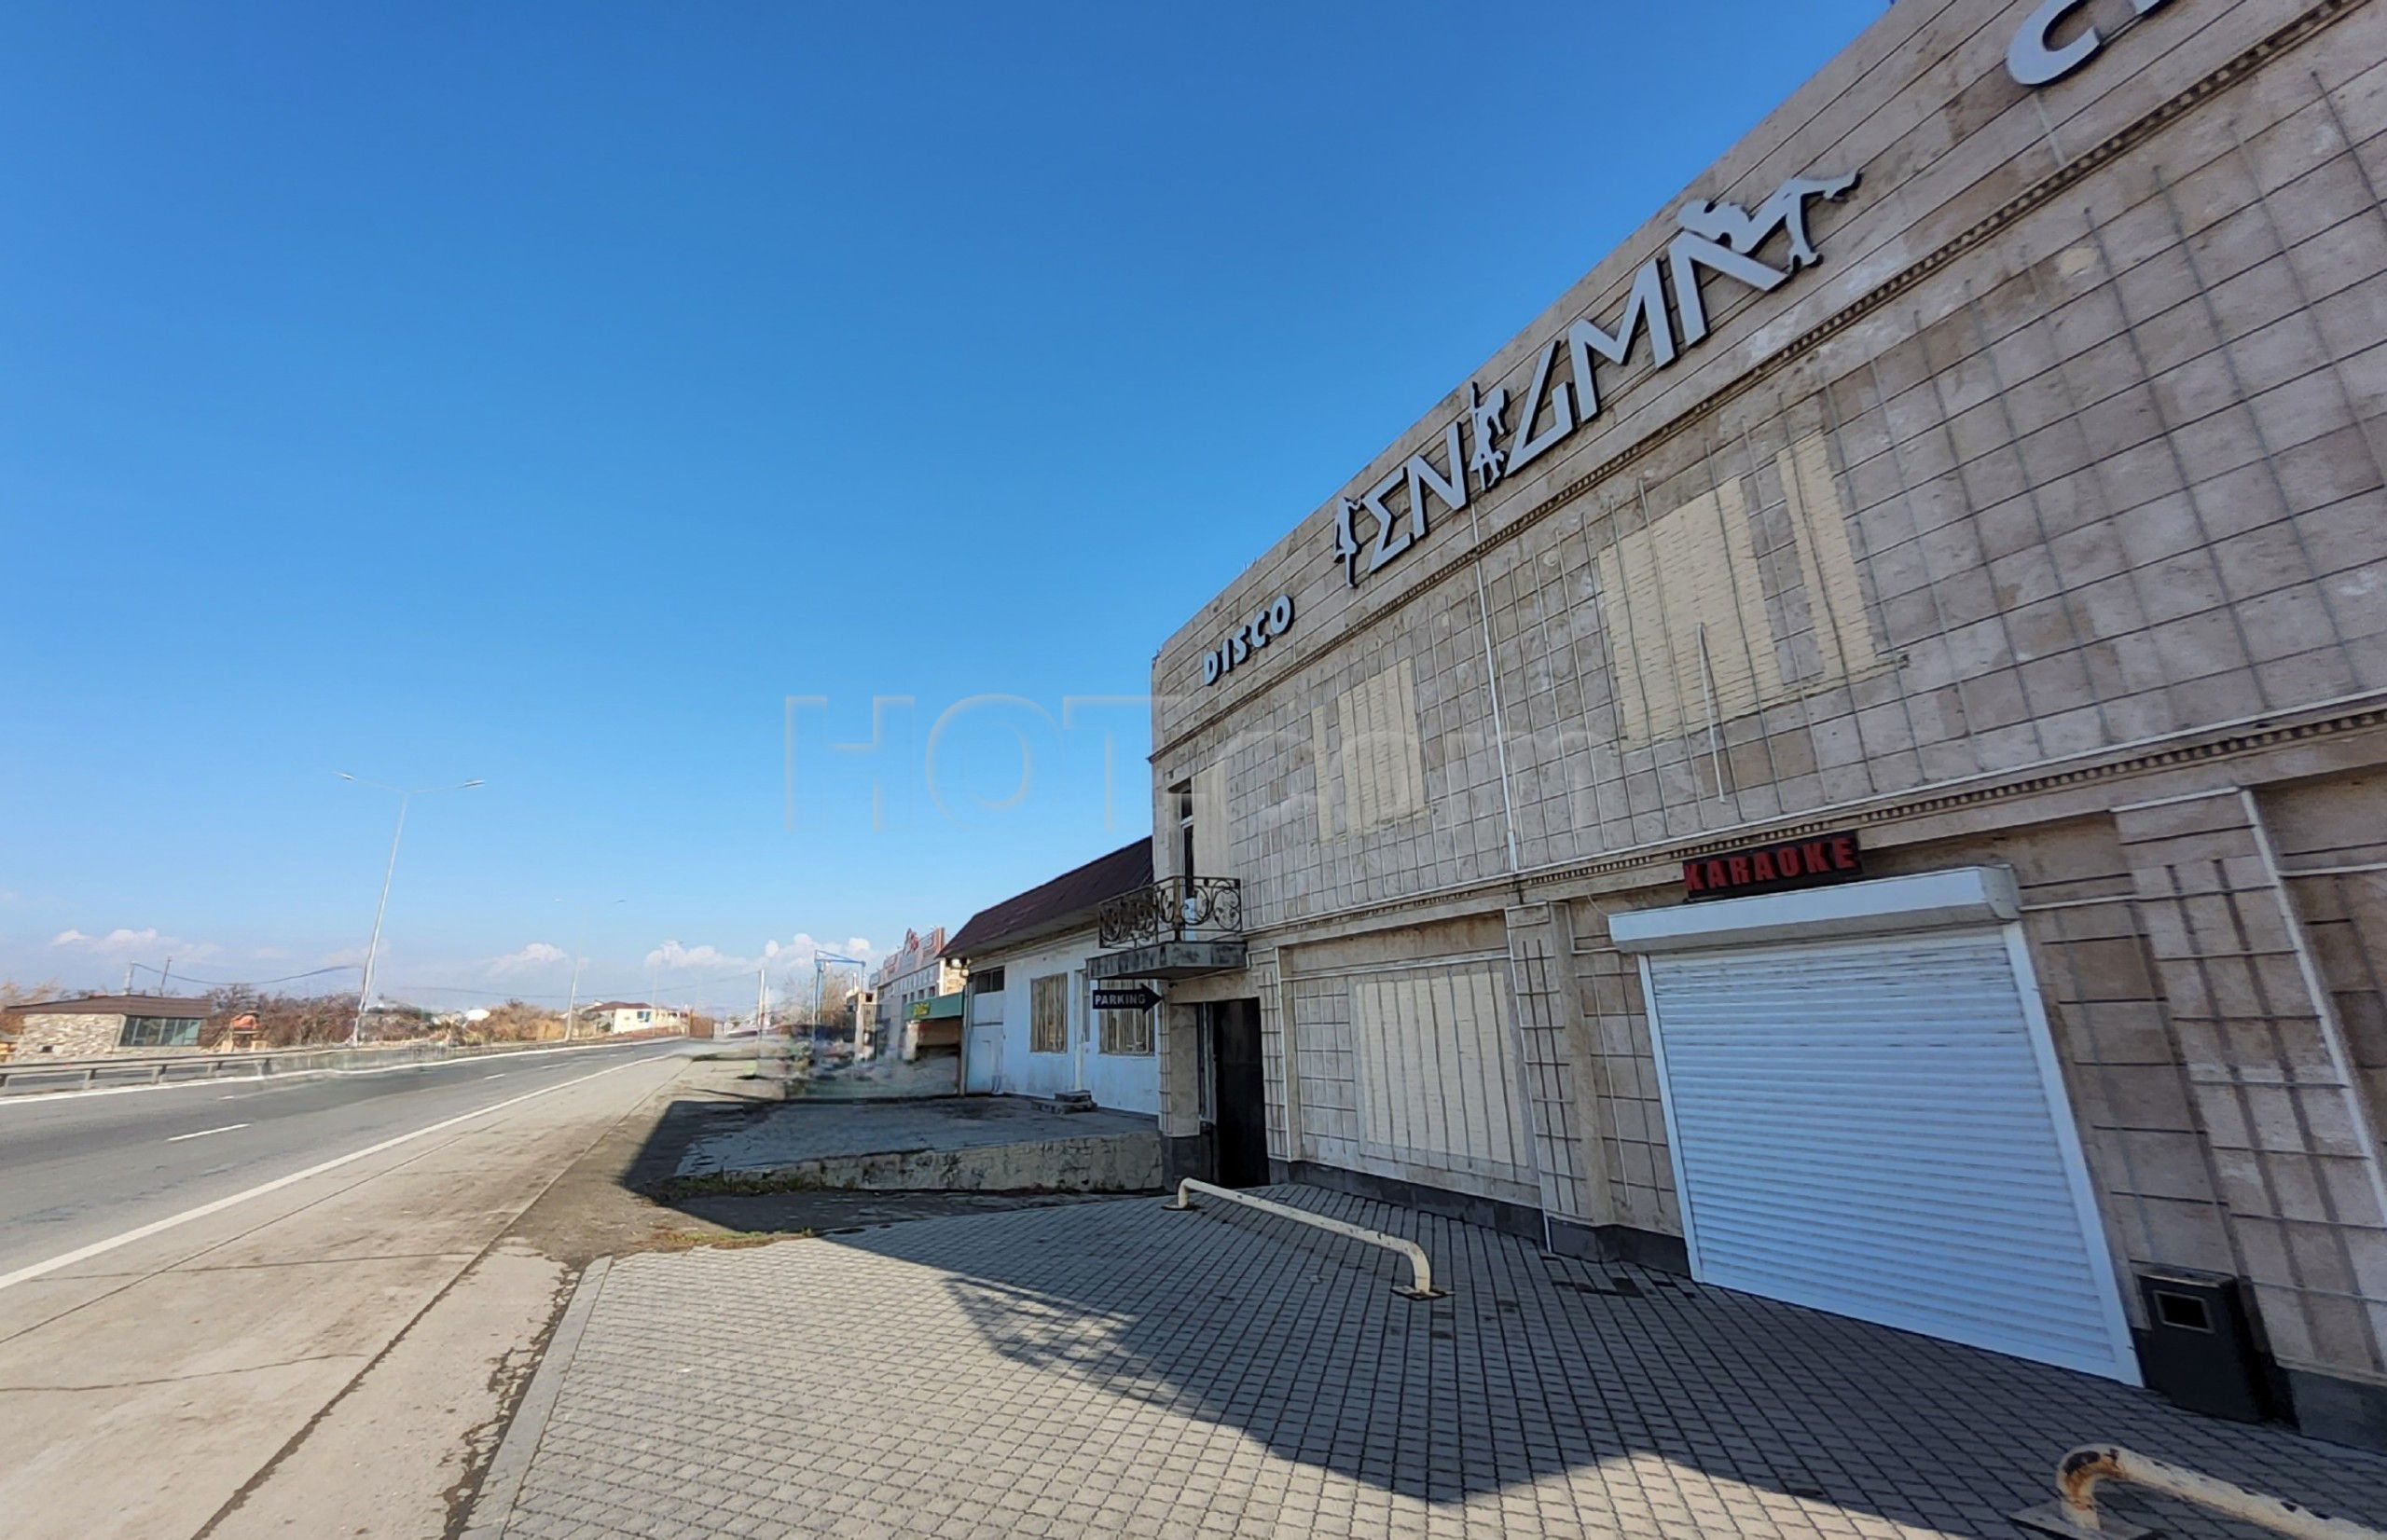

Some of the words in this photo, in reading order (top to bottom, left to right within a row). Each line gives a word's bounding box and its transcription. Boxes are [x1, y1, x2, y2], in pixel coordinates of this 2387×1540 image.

[1203, 595, 1294, 686] DISCO
[1683, 838, 1856, 891] KARAOKE
[1094, 993, 1146, 1006] PARKING
